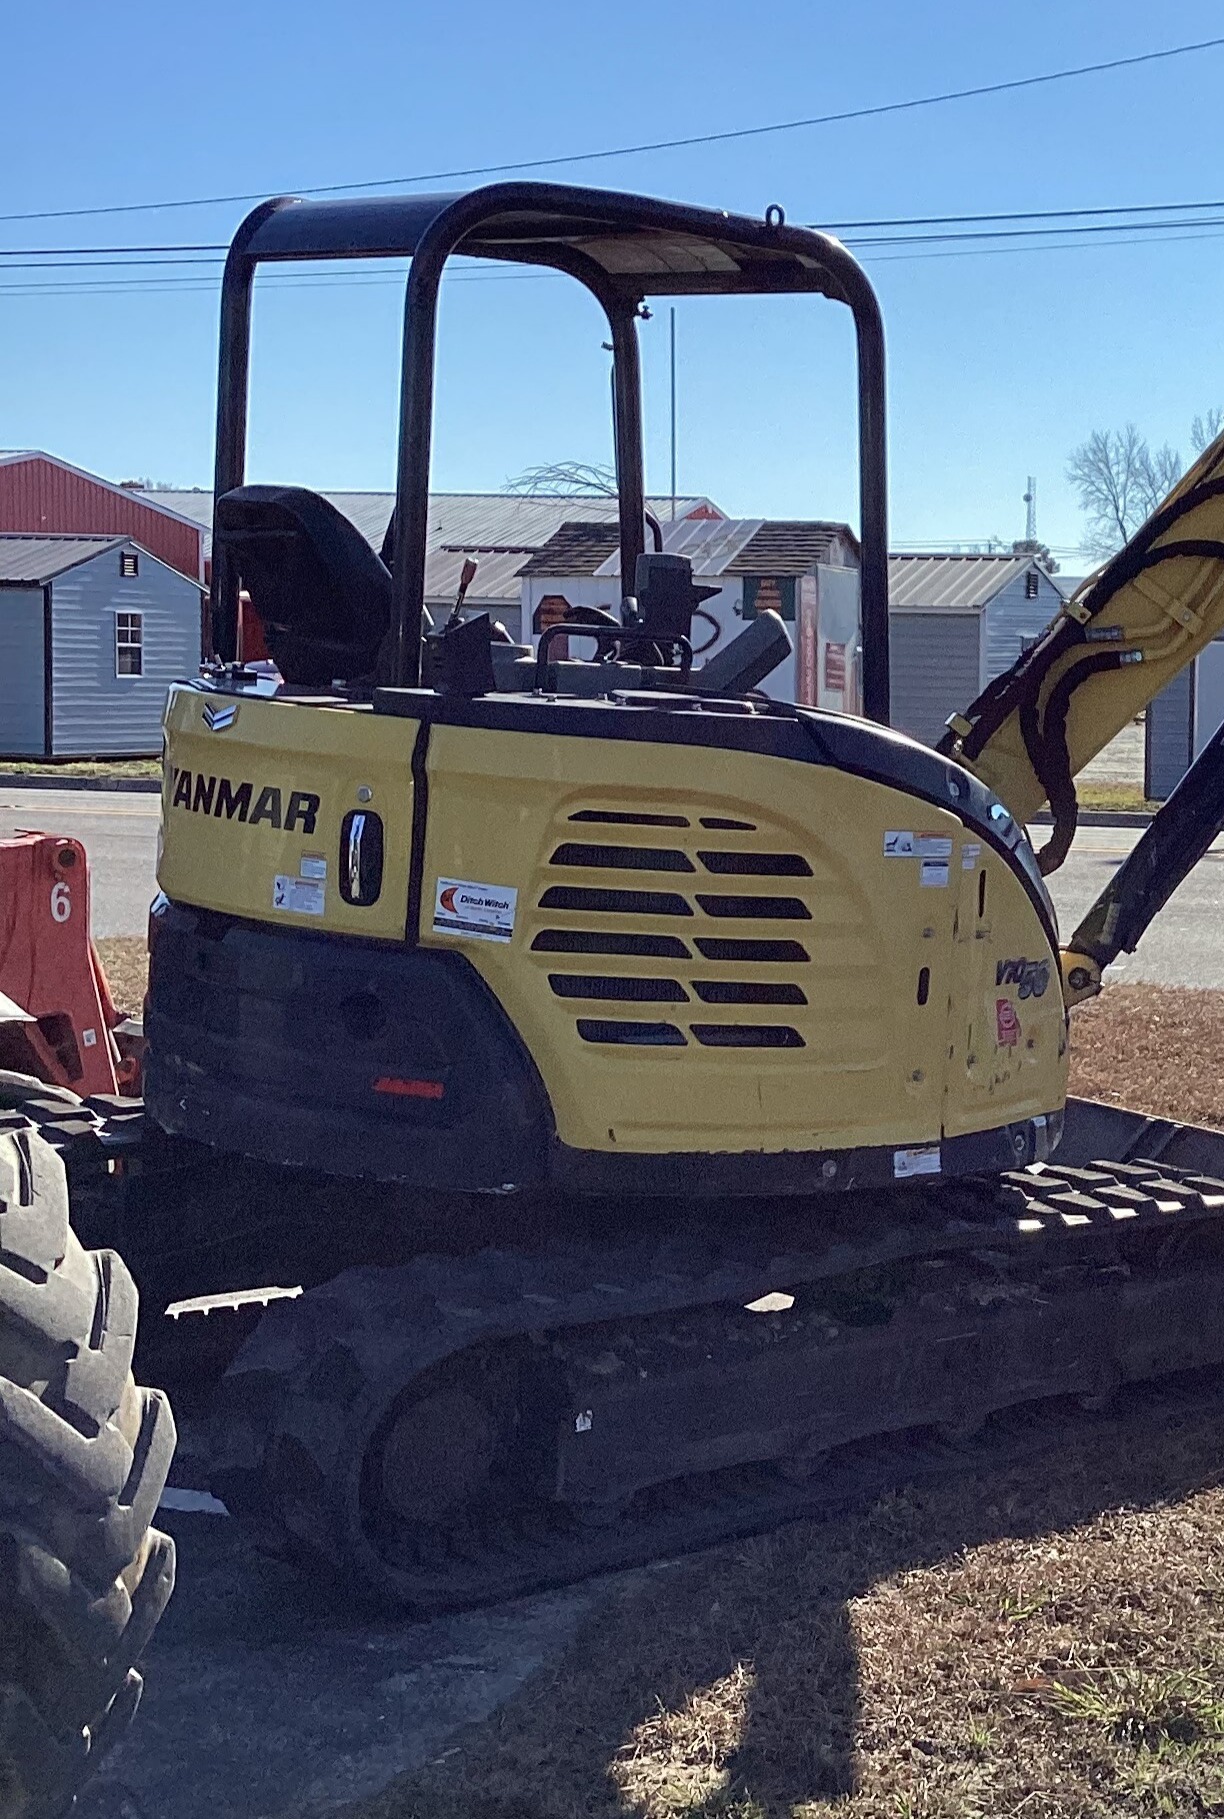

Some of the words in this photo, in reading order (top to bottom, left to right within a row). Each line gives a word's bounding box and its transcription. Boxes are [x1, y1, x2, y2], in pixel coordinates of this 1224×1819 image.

[50, 881, 72, 923] 6
[460, 894, 484, 906] Ditch
[485, 899, 510, 909] Witch
